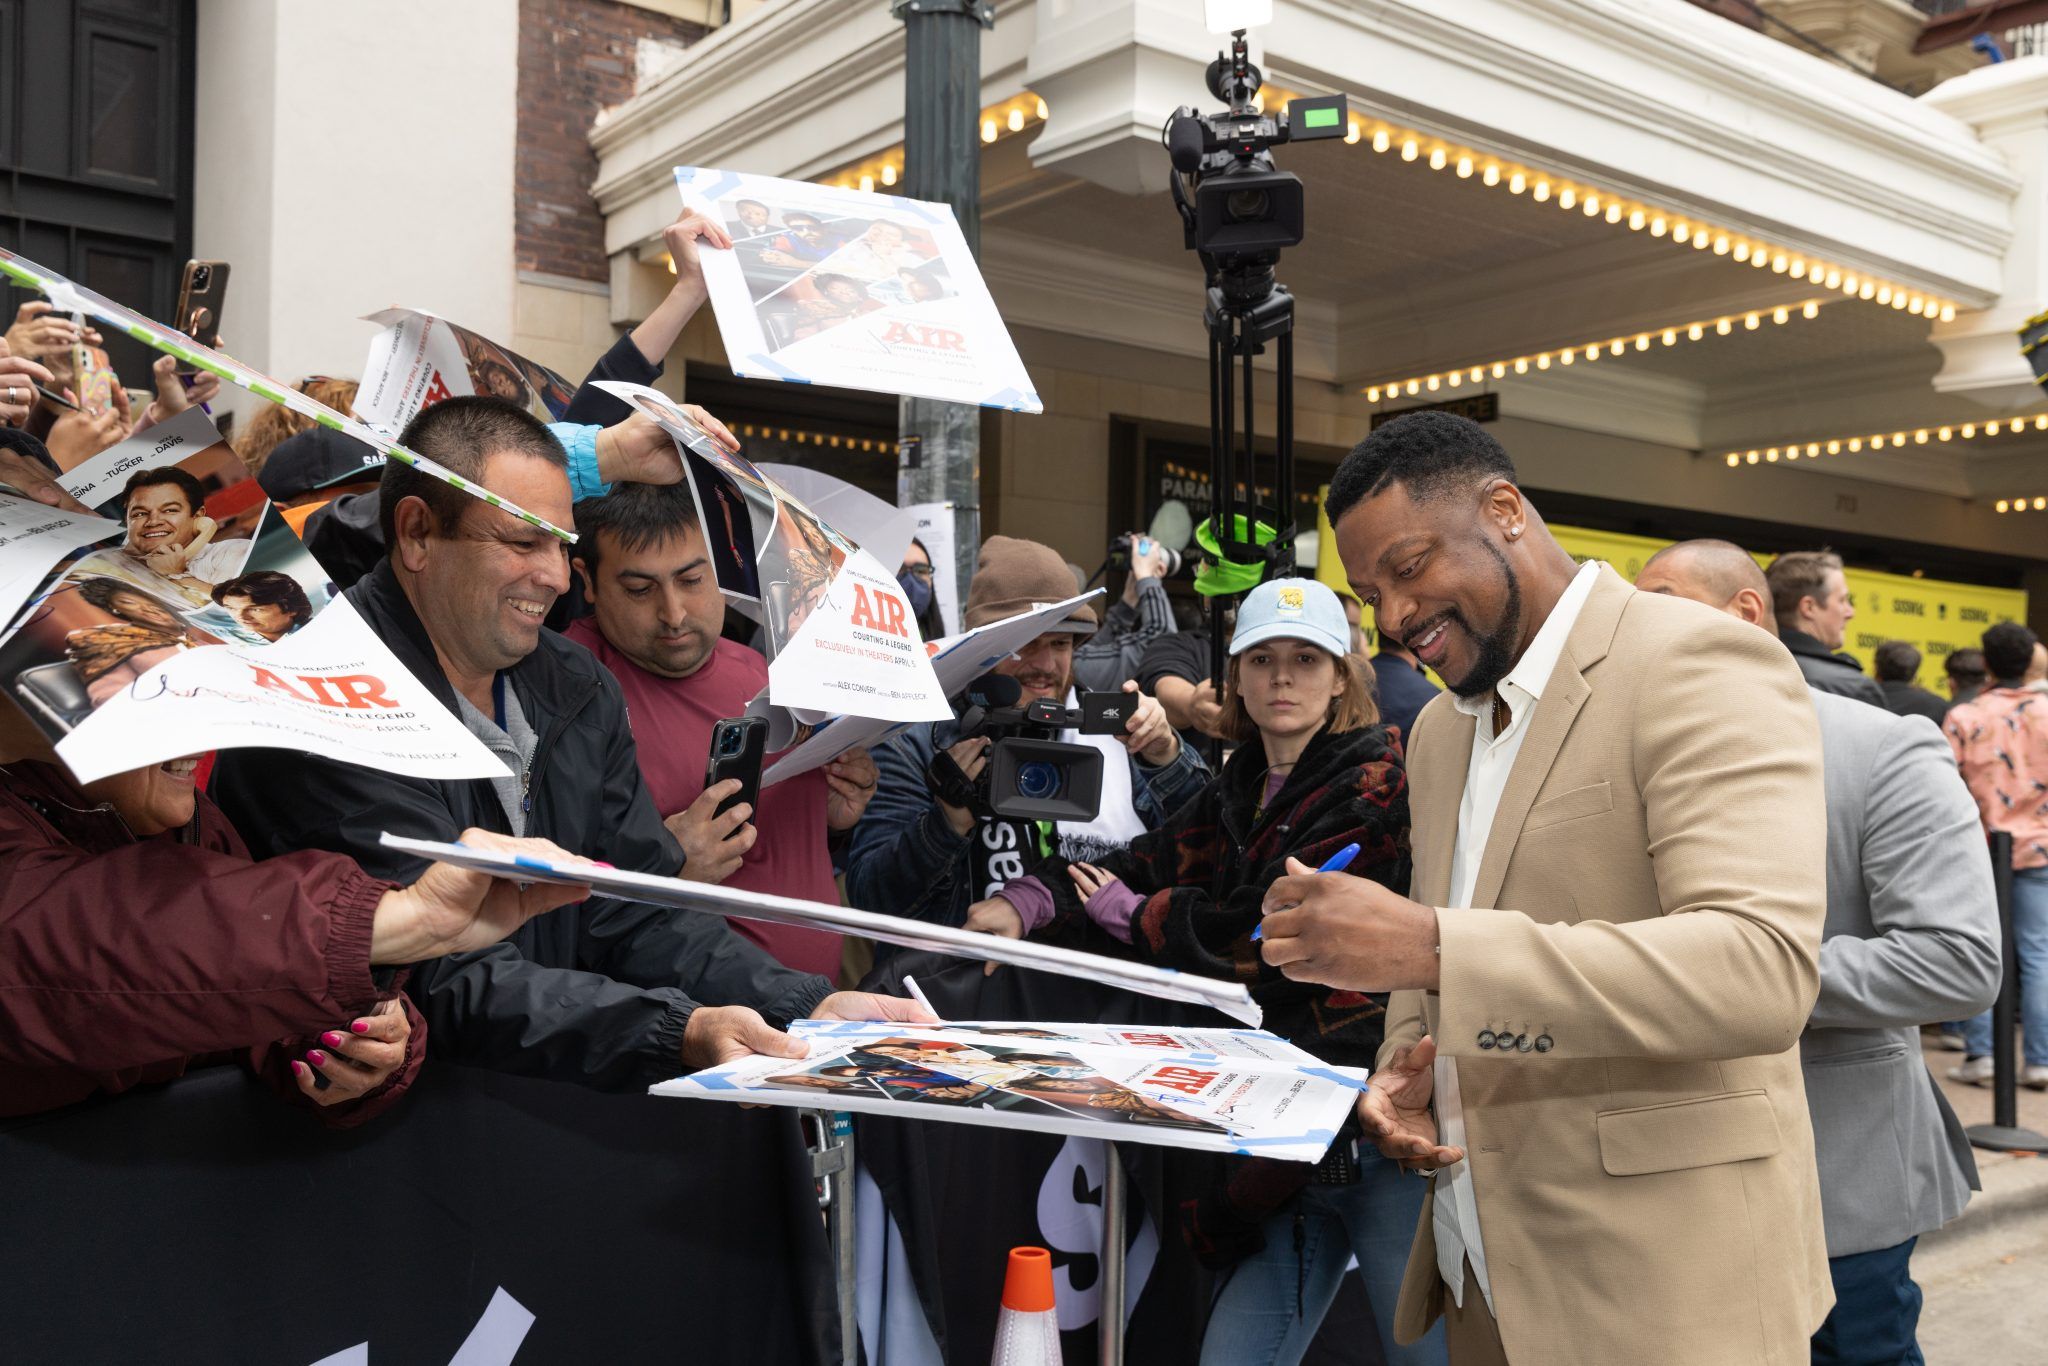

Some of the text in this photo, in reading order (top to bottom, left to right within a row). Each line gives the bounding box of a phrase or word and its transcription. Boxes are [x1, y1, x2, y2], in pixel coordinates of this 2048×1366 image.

[882, 320, 967, 352] AIR
[155, 436, 184, 454] DAVIS
[106, 456, 144, 478] TUCKER
[113, 457, 129, 467] CHRIS
[73, 483, 96, 499] SINA
[851, 583, 908, 638] AIR
[852, 631, 884, 646] COURTING
[885, 639, 890, 647] A
[890, 640, 912, 652] LEGEND
[815, 638, 856, 656] EXCLUSIVELY
[857, 647, 865, 657] IN
[865, 649, 894, 664] THEATERS
[894, 656, 911, 668] APRIL
[248, 664, 401, 709] AIR
[837, 680, 851, 691] ALEX
[851, 682, 877, 695] CONVERY
[891, 690, 901, 699] BEN
[358, 711, 416, 720] LEGEND
[1103, 708, 1120, 716] 4K
[376, 724, 420, 733] APRIL
[1142, 1066, 1220, 1094] AIR
